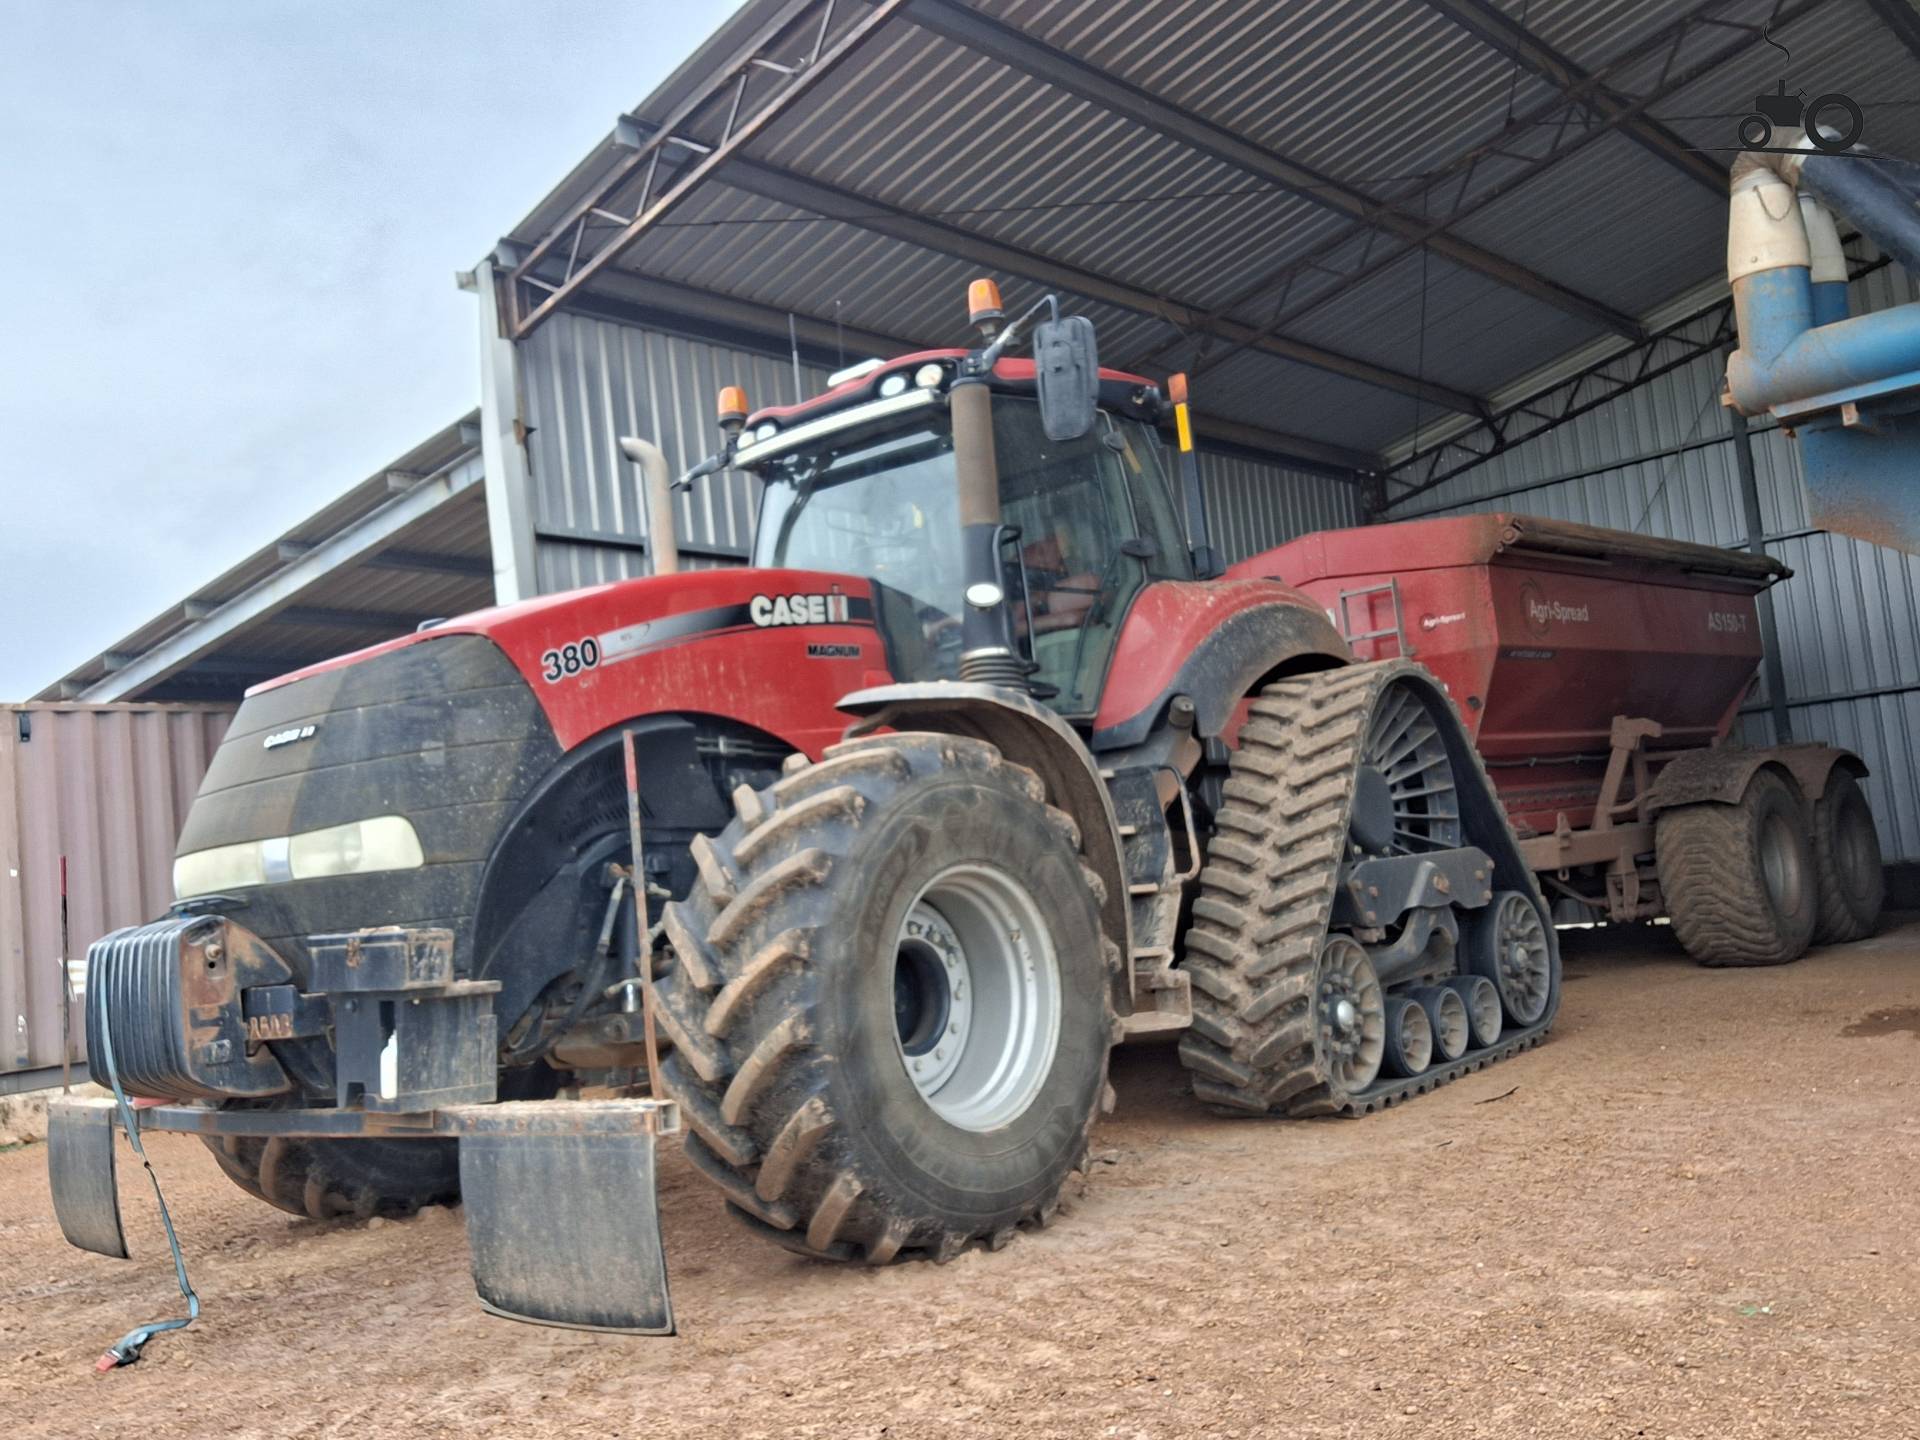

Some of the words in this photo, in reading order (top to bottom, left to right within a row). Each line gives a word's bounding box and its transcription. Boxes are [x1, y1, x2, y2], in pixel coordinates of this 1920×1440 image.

[1530, 600, 1590, 623] Agri-Spread
[541, 635, 599, 684] 380
[807, 645, 860, 657] MAGNUM
